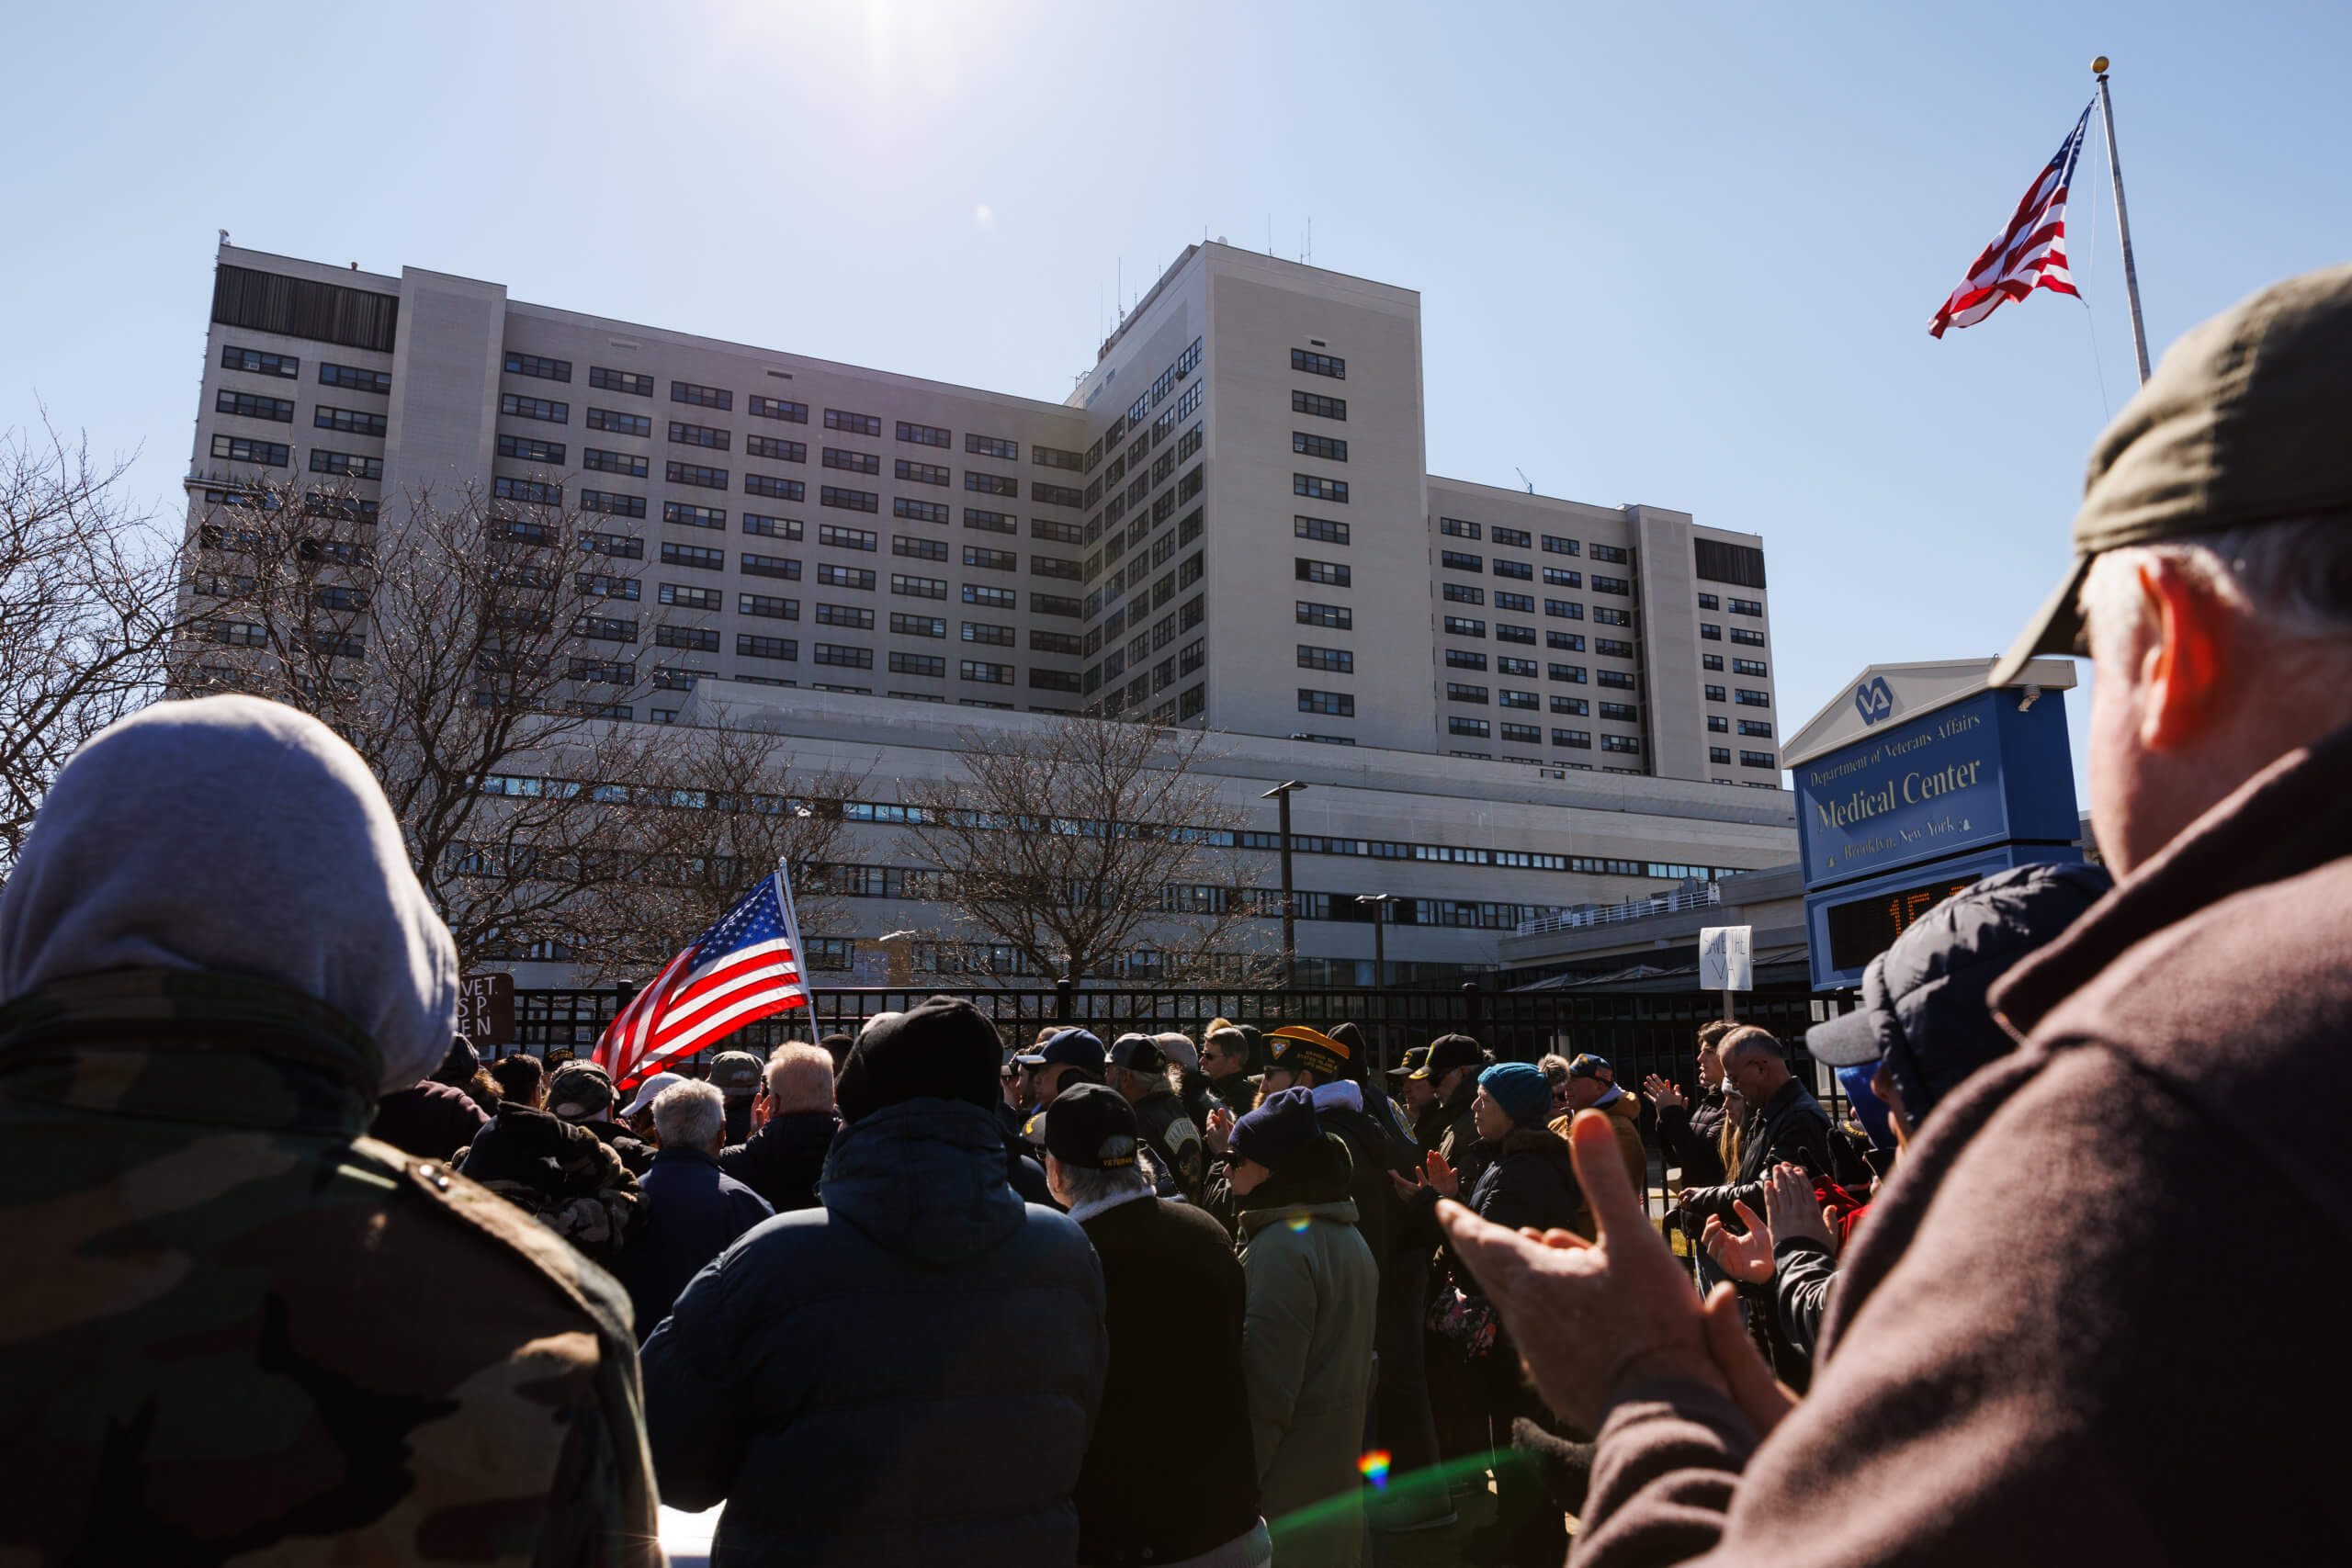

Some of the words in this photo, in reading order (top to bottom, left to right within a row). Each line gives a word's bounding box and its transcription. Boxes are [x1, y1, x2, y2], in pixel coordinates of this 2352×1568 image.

[1810, 755, 1868, 787] Department
[1870, 747, 1881, 764] of
[1884, 733, 1932, 758] Veterans
[1938, 713, 1981, 739] Affairs
[1816, 780, 1896, 832] Medical
[1903, 760, 1981, 805] Center
[1844, 837, 1896, 861] Brooklyn,
[1899, 829, 1922, 843] New
[1926, 816, 1955, 837] York
[1704, 931, 1726, 955] SAVE
[1727, 931, 1747, 955] THE
[461, 976, 498, 997] VET.
[1711, 956, 1736, 982] VA
